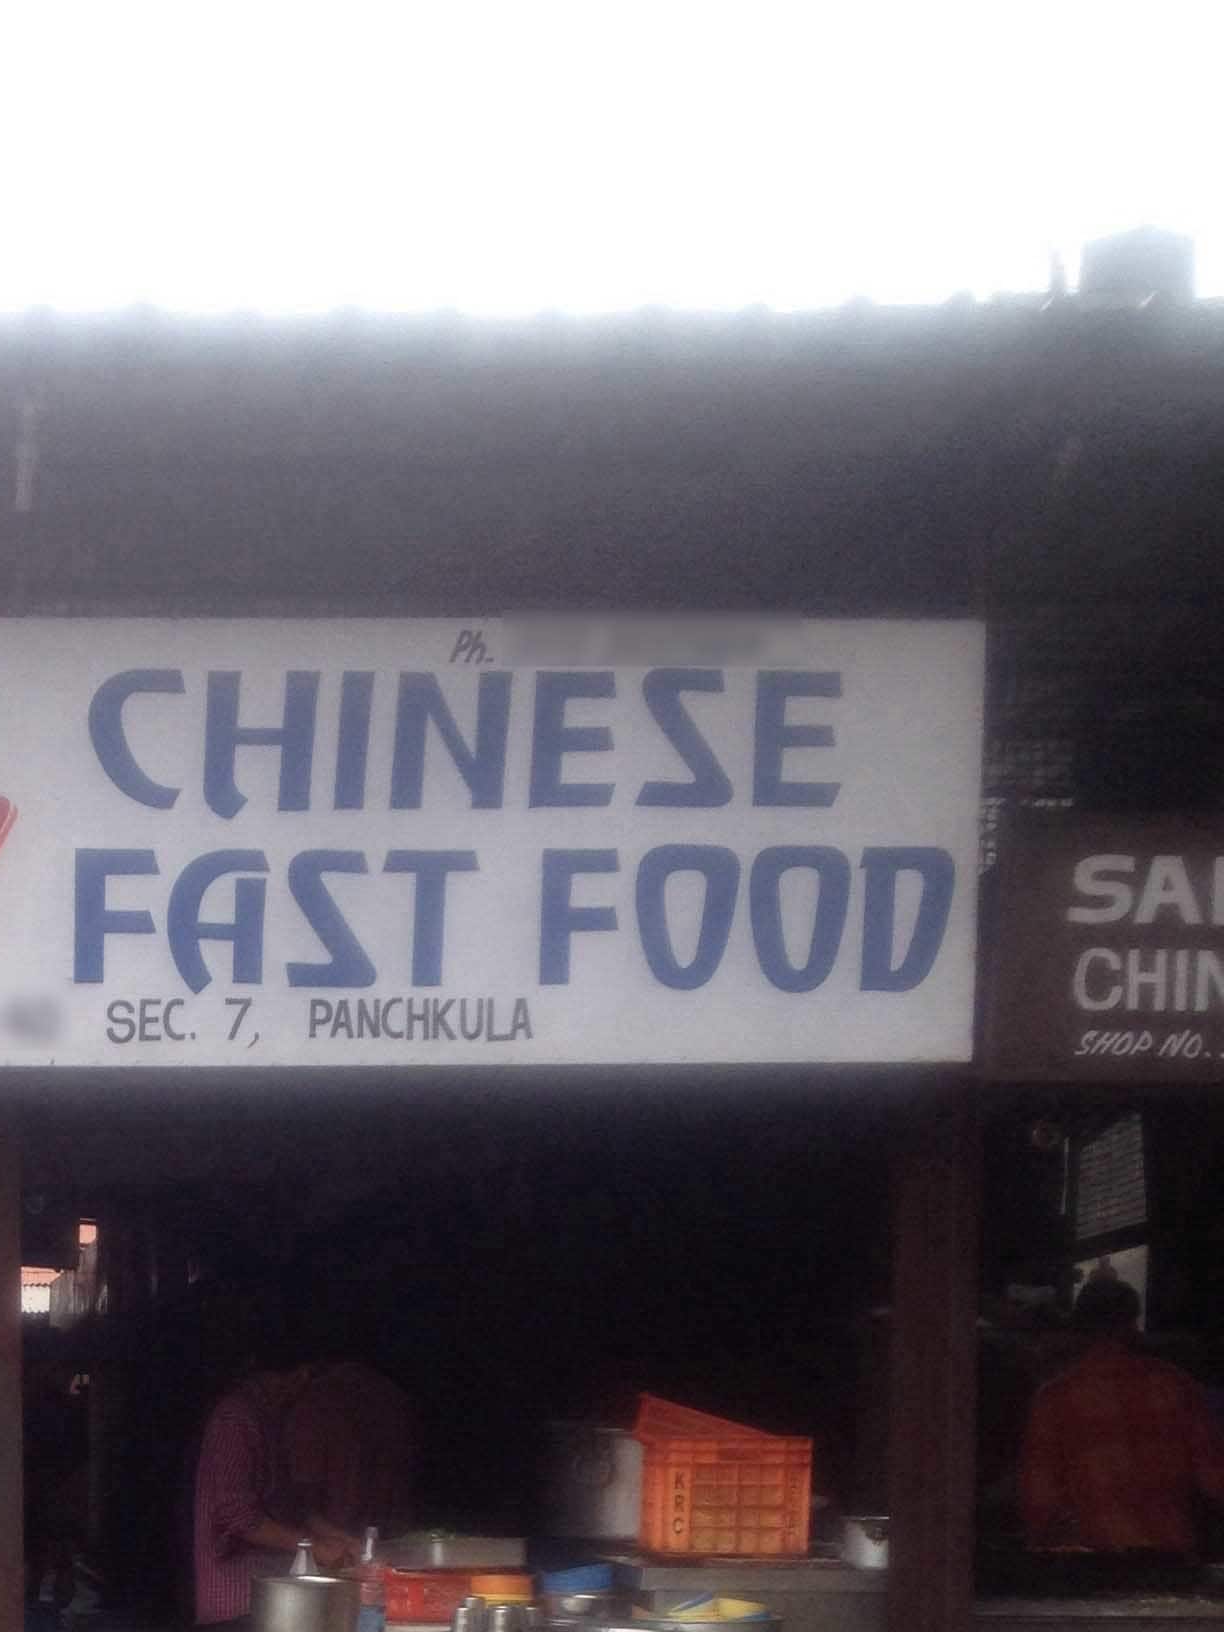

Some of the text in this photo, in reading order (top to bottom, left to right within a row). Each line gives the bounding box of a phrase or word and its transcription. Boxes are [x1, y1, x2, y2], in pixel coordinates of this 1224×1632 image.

[447, 629, 495, 664] Ph.
[87, 667, 844, 820] CHINESE
[1067, 854, 1224, 925] SA
[73, 844, 957, 996] FAST FOOD
[106, 1000, 197, 1043] SEC.
[225, 999, 260, 1048] 7,
[308, 998, 535, 1042] PANCHKULA
[1075, 1029, 1154, 1056] SHOP
